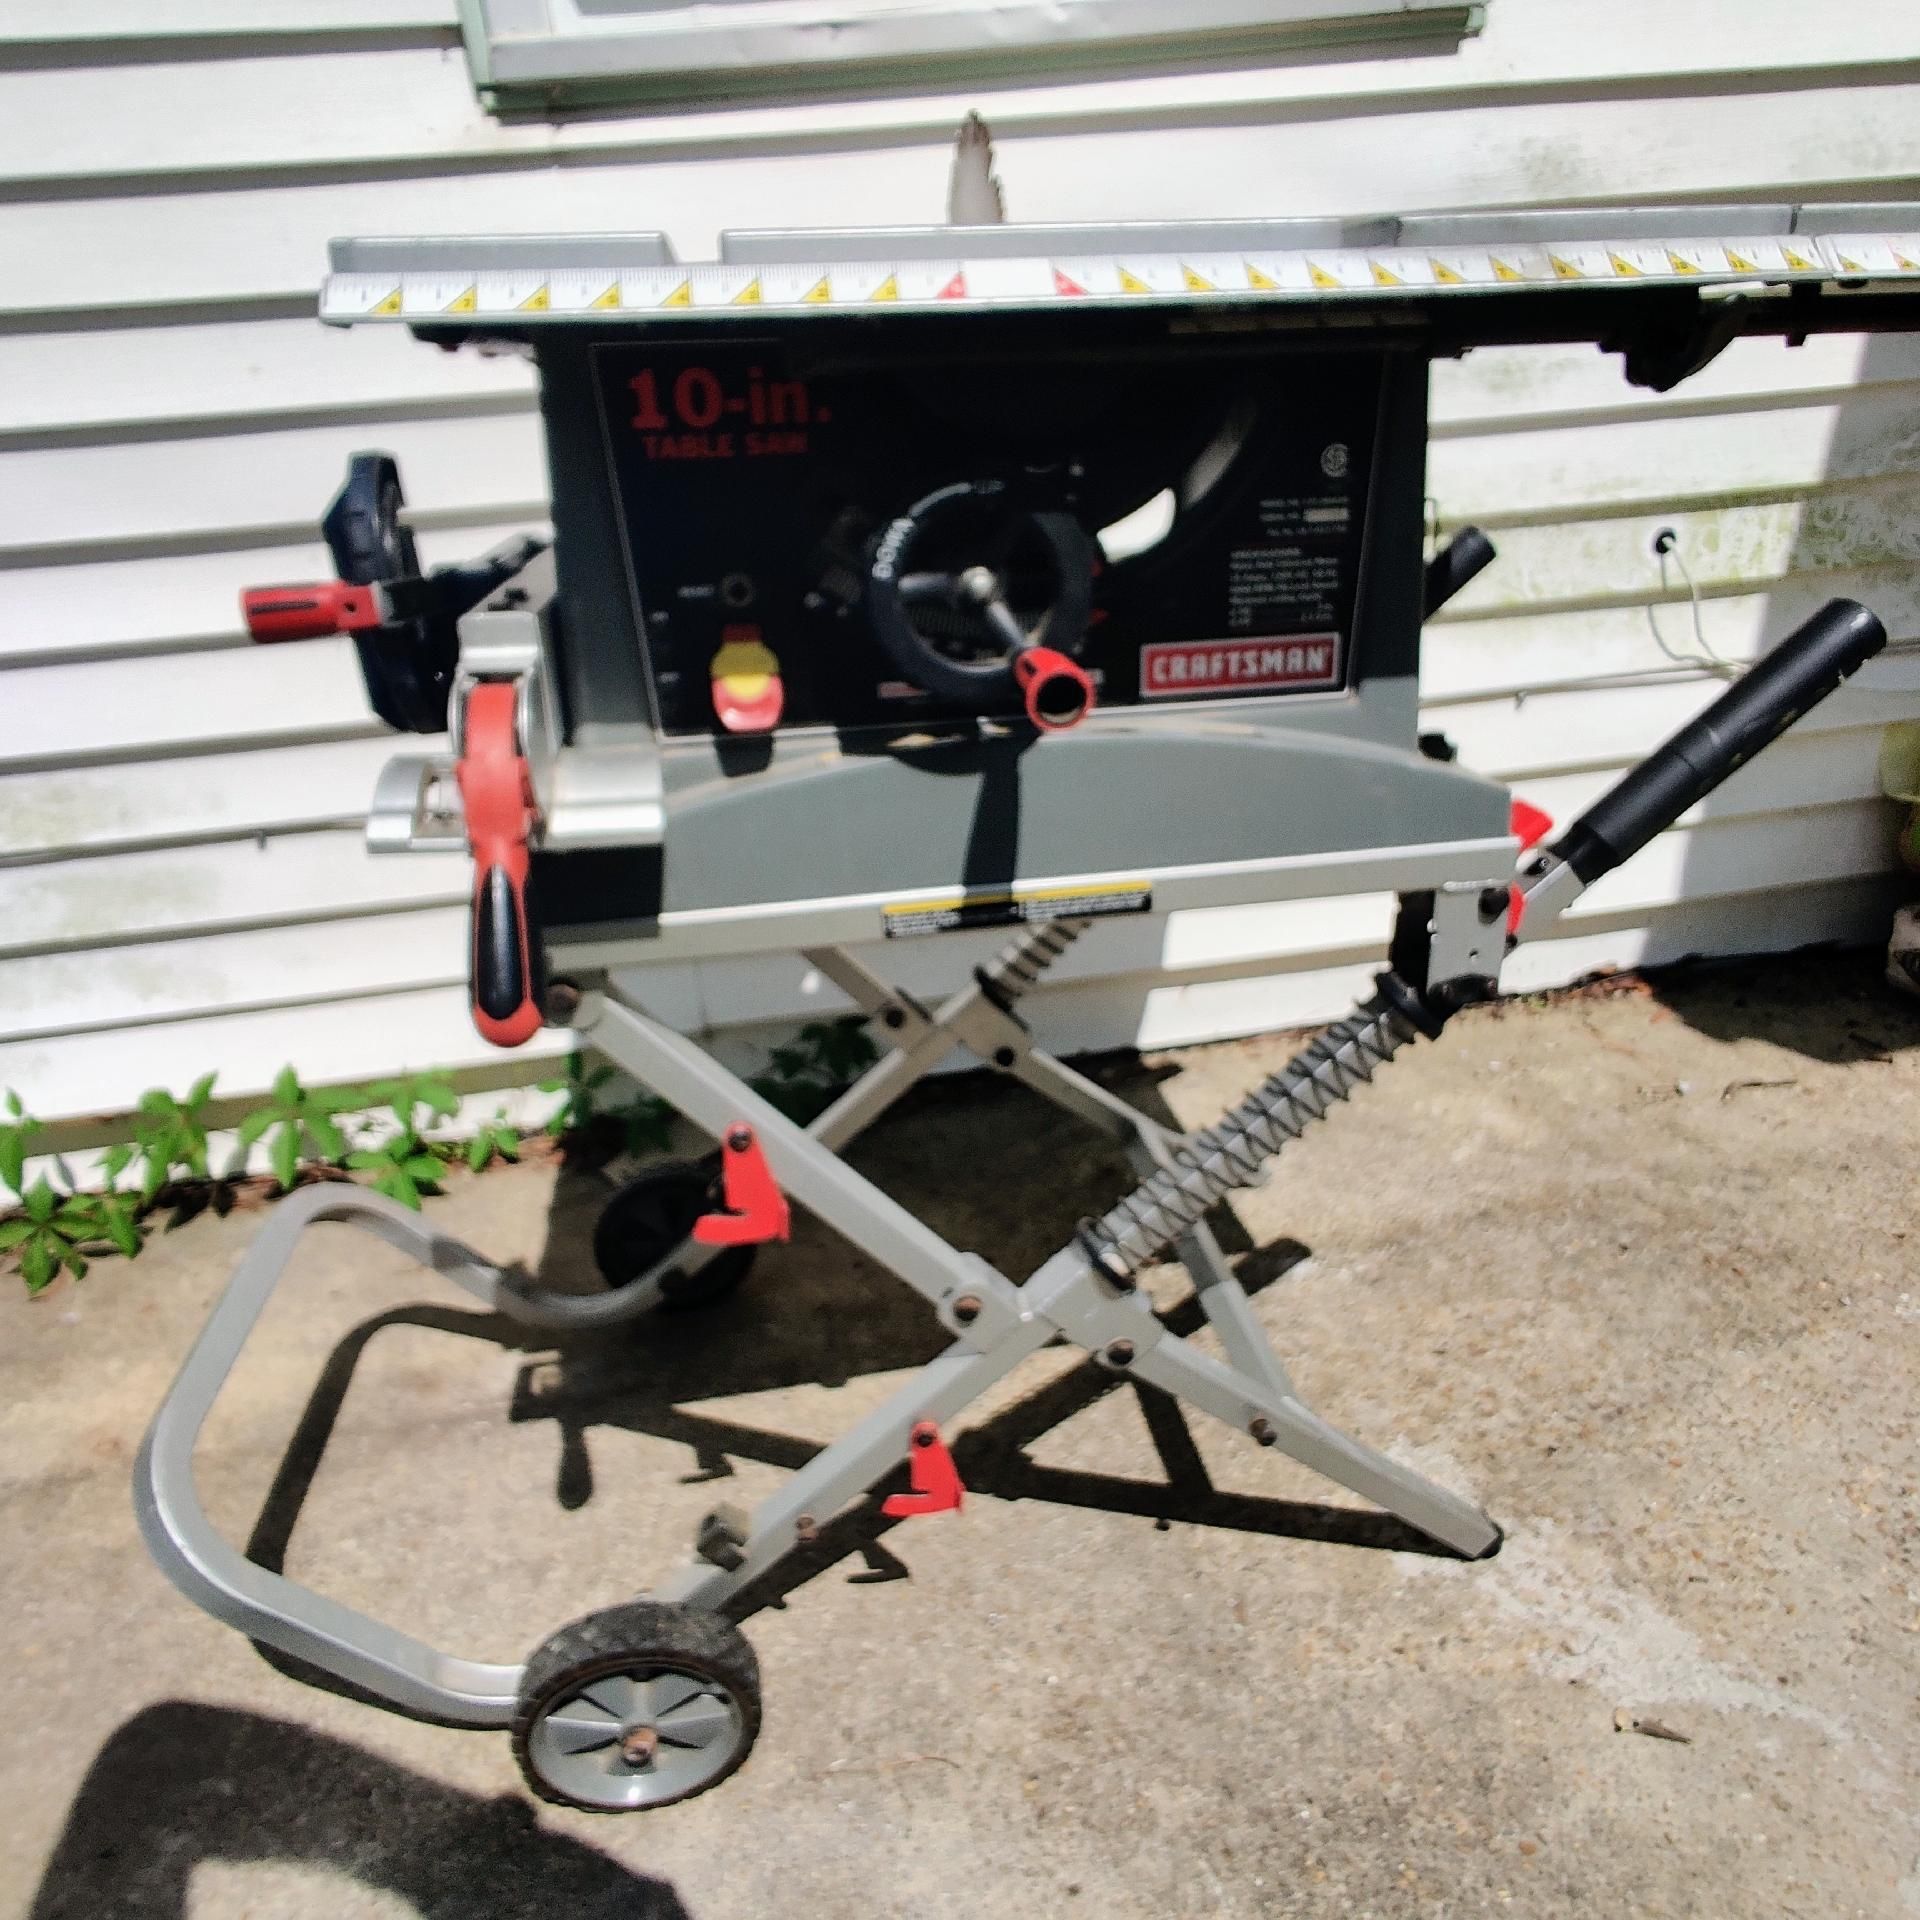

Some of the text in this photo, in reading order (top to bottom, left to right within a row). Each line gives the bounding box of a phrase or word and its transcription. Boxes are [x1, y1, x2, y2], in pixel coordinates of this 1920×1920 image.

[628, 367, 832, 429] 10-in.
[641, 433, 735, 460] TABLE
[871, 518, 916, 579] DOWN
[1151, 647, 1327, 683] CRAFTSMAN
